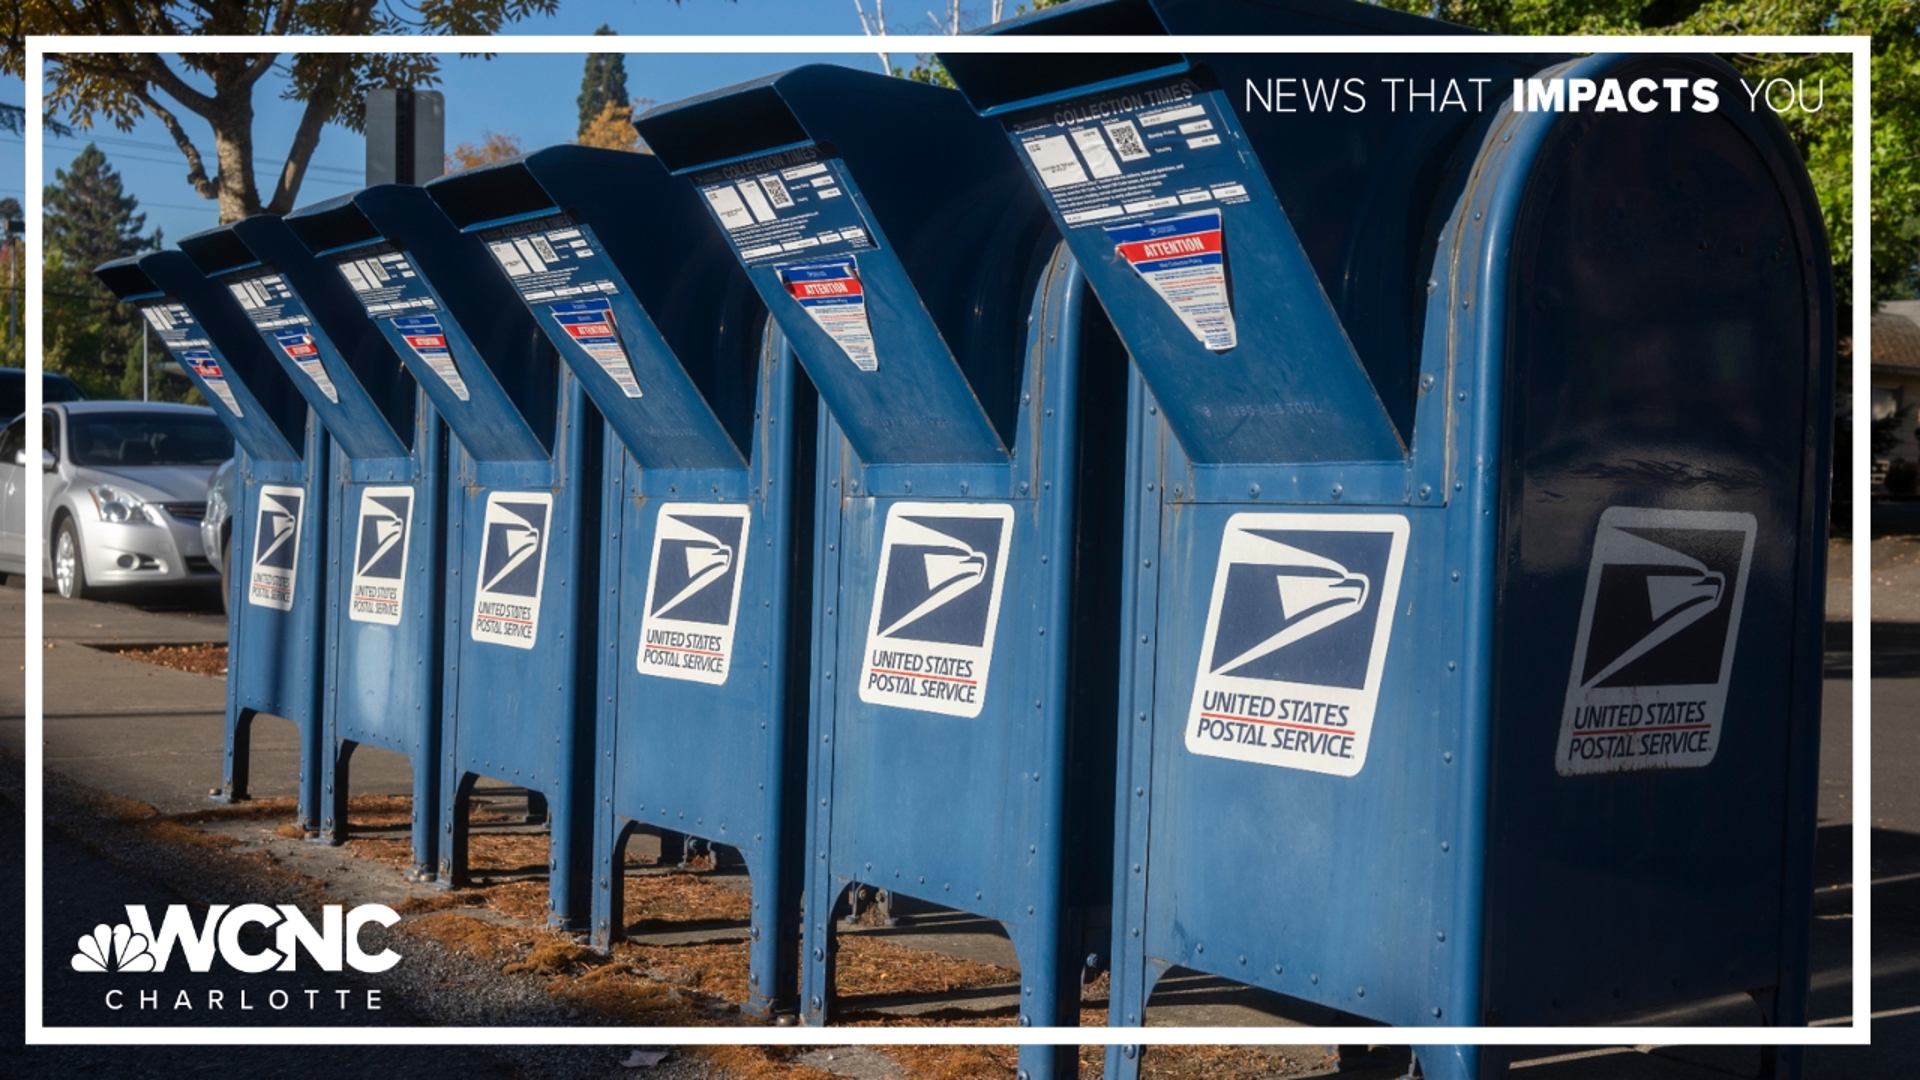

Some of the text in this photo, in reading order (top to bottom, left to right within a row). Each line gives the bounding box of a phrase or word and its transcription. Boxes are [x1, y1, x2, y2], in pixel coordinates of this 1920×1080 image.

[1053, 96, 1145, 128] COLLECTION
[1145, 82, 1193, 107] TIMES
[722, 147, 817, 180] COLLECTION TIMES
[1143, 236, 1205, 258] ATTENTION
[803, 281, 849, 296] ATTENTION
[478, 601, 532, 620] UNITED STATES
[476, 618, 533, 639] POSTAL SERVICE
[646, 628, 722, 652] UNITED STATES
[643, 648, 724, 673] POSTAL SERVICE
[872, 649, 974, 678] UNITED STATES
[868, 672, 977, 704] POSTAL SERVICE
[1202, 690, 1350, 727] UNITED STATES
[1573, 701, 1707, 730] UNITED STATES
[1197, 717, 1355, 759] POSTAL SERVICE
[1568, 730, 1711, 761] POSTAL SERVICE
